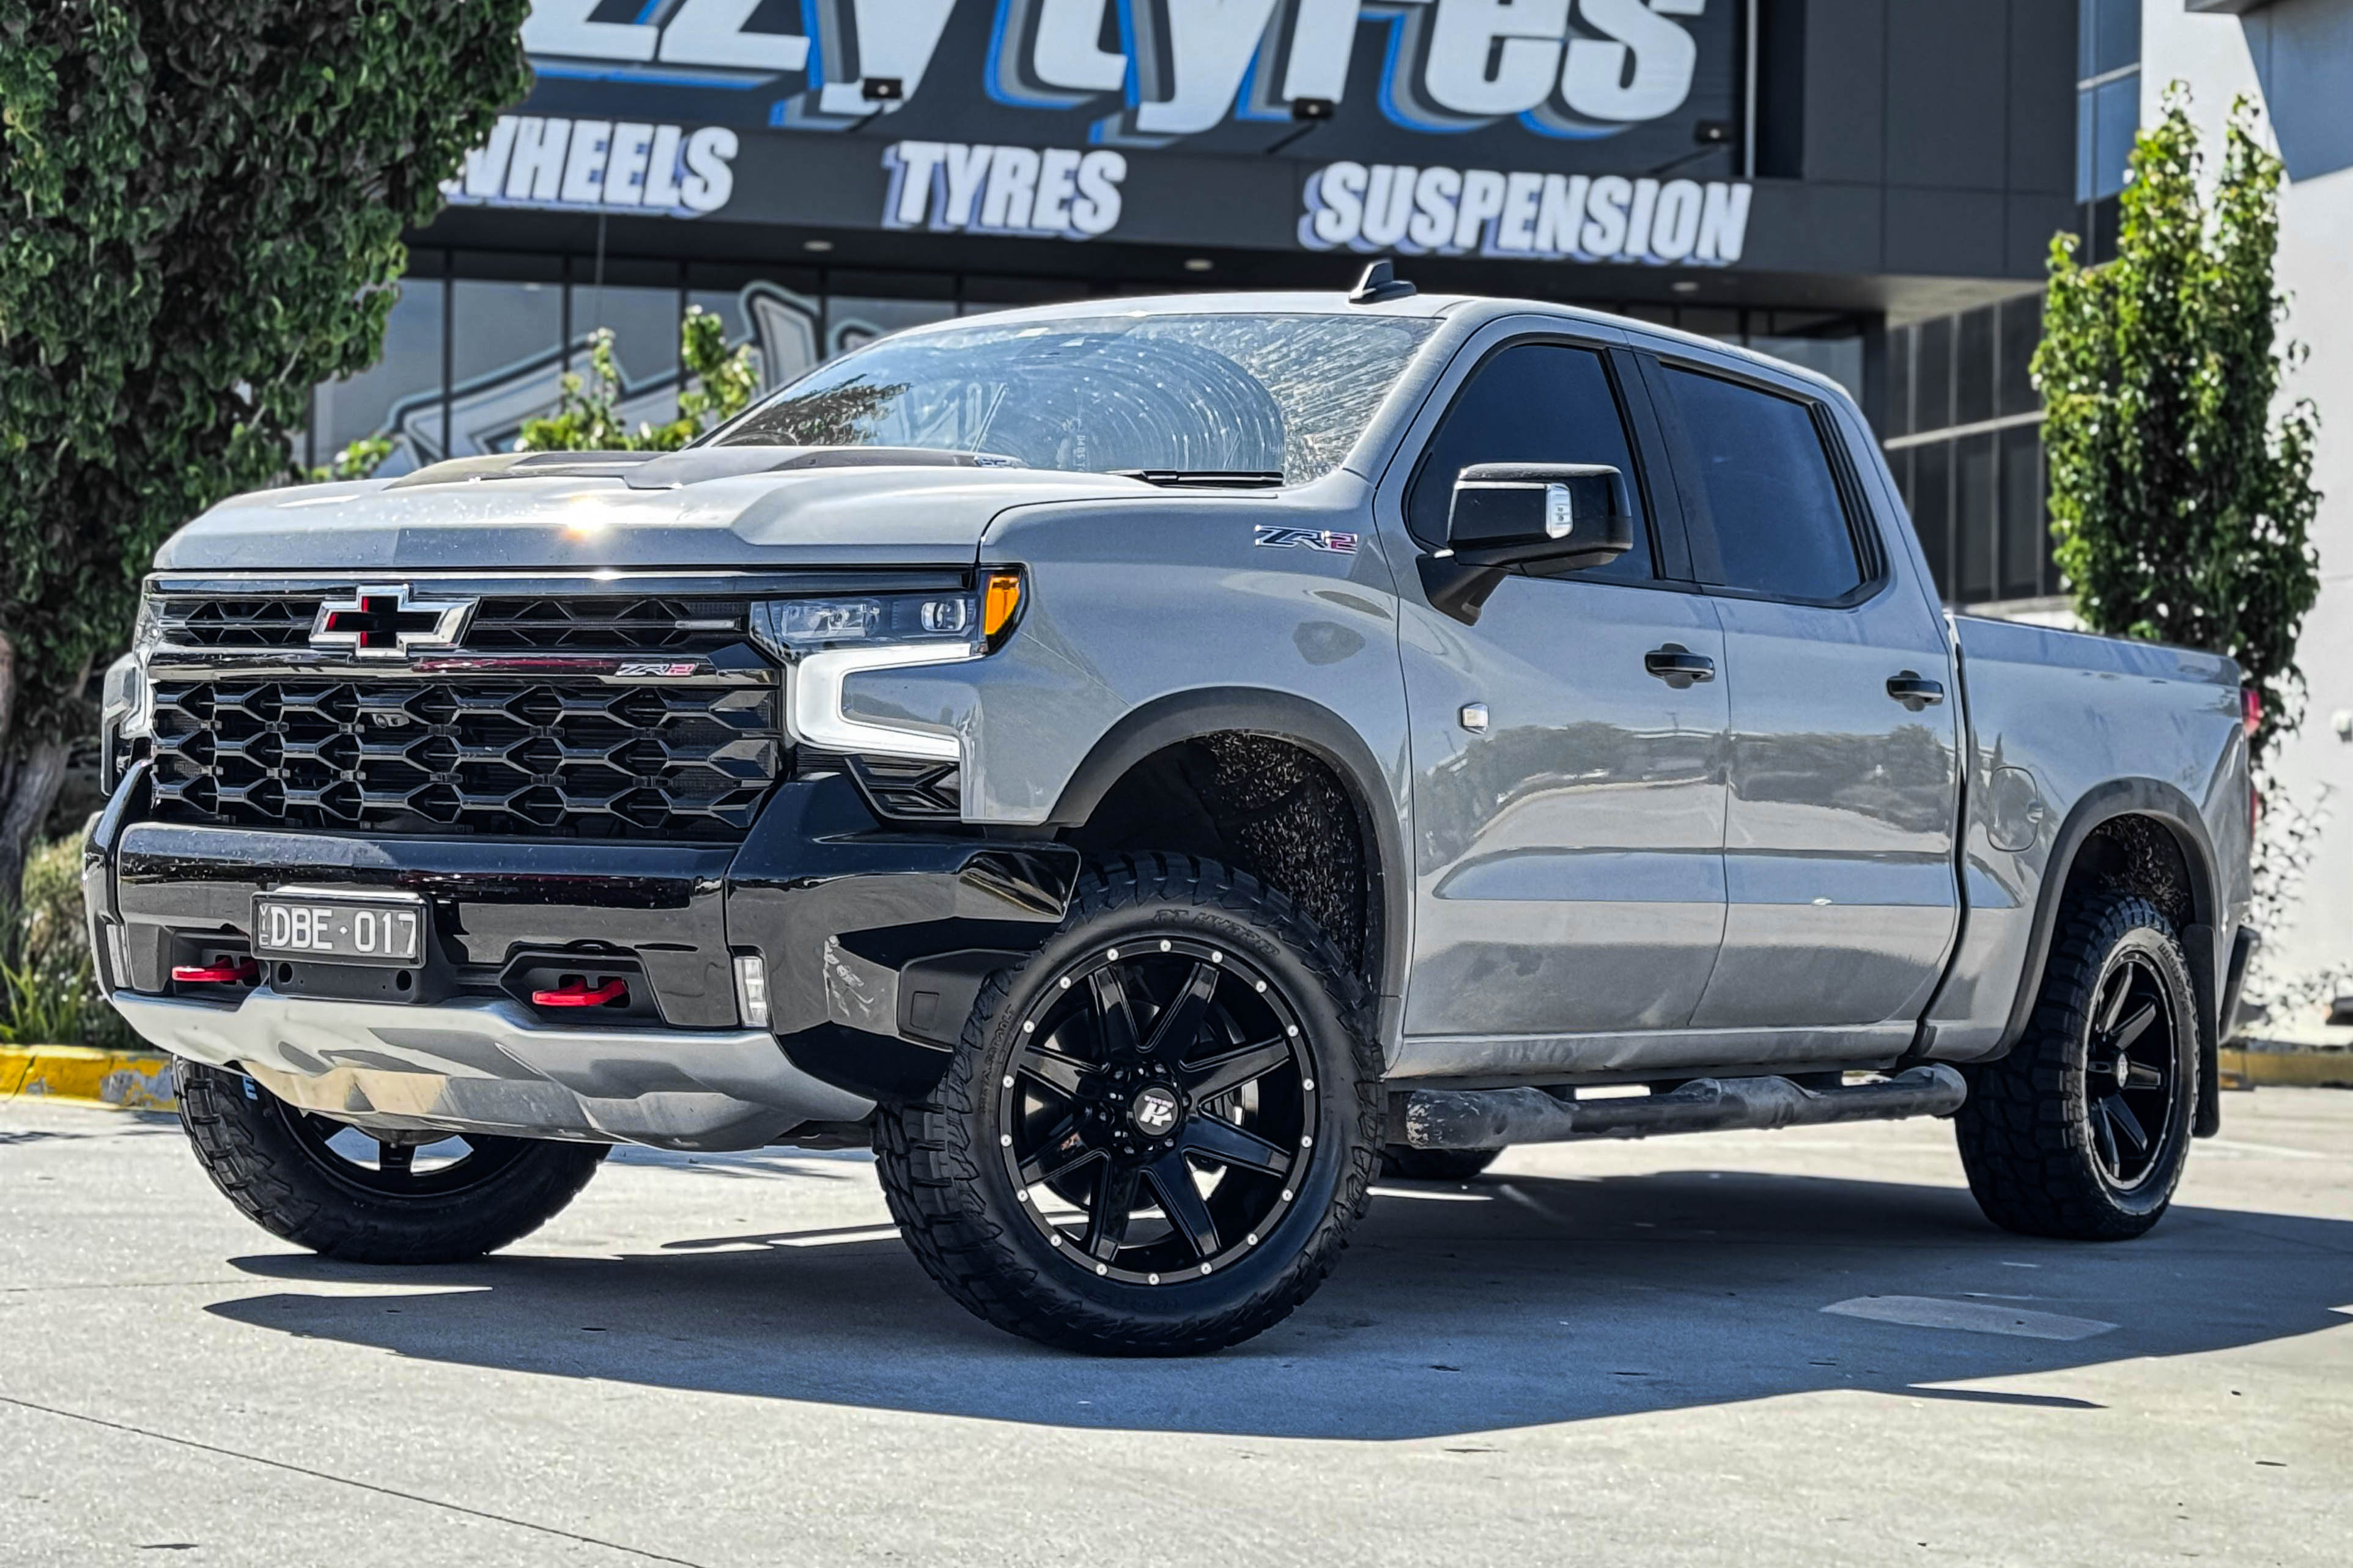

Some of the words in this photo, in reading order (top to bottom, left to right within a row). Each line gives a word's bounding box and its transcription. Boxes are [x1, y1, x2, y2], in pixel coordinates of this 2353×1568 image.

[438, 114, 739, 213] WHEELS
[895, 140, 1128, 235] TYRES
[1312, 161, 1754, 260] SUSPENSION
[1254, 525, 1359, 554] ZR2
[615, 662, 698, 677] ZR2
